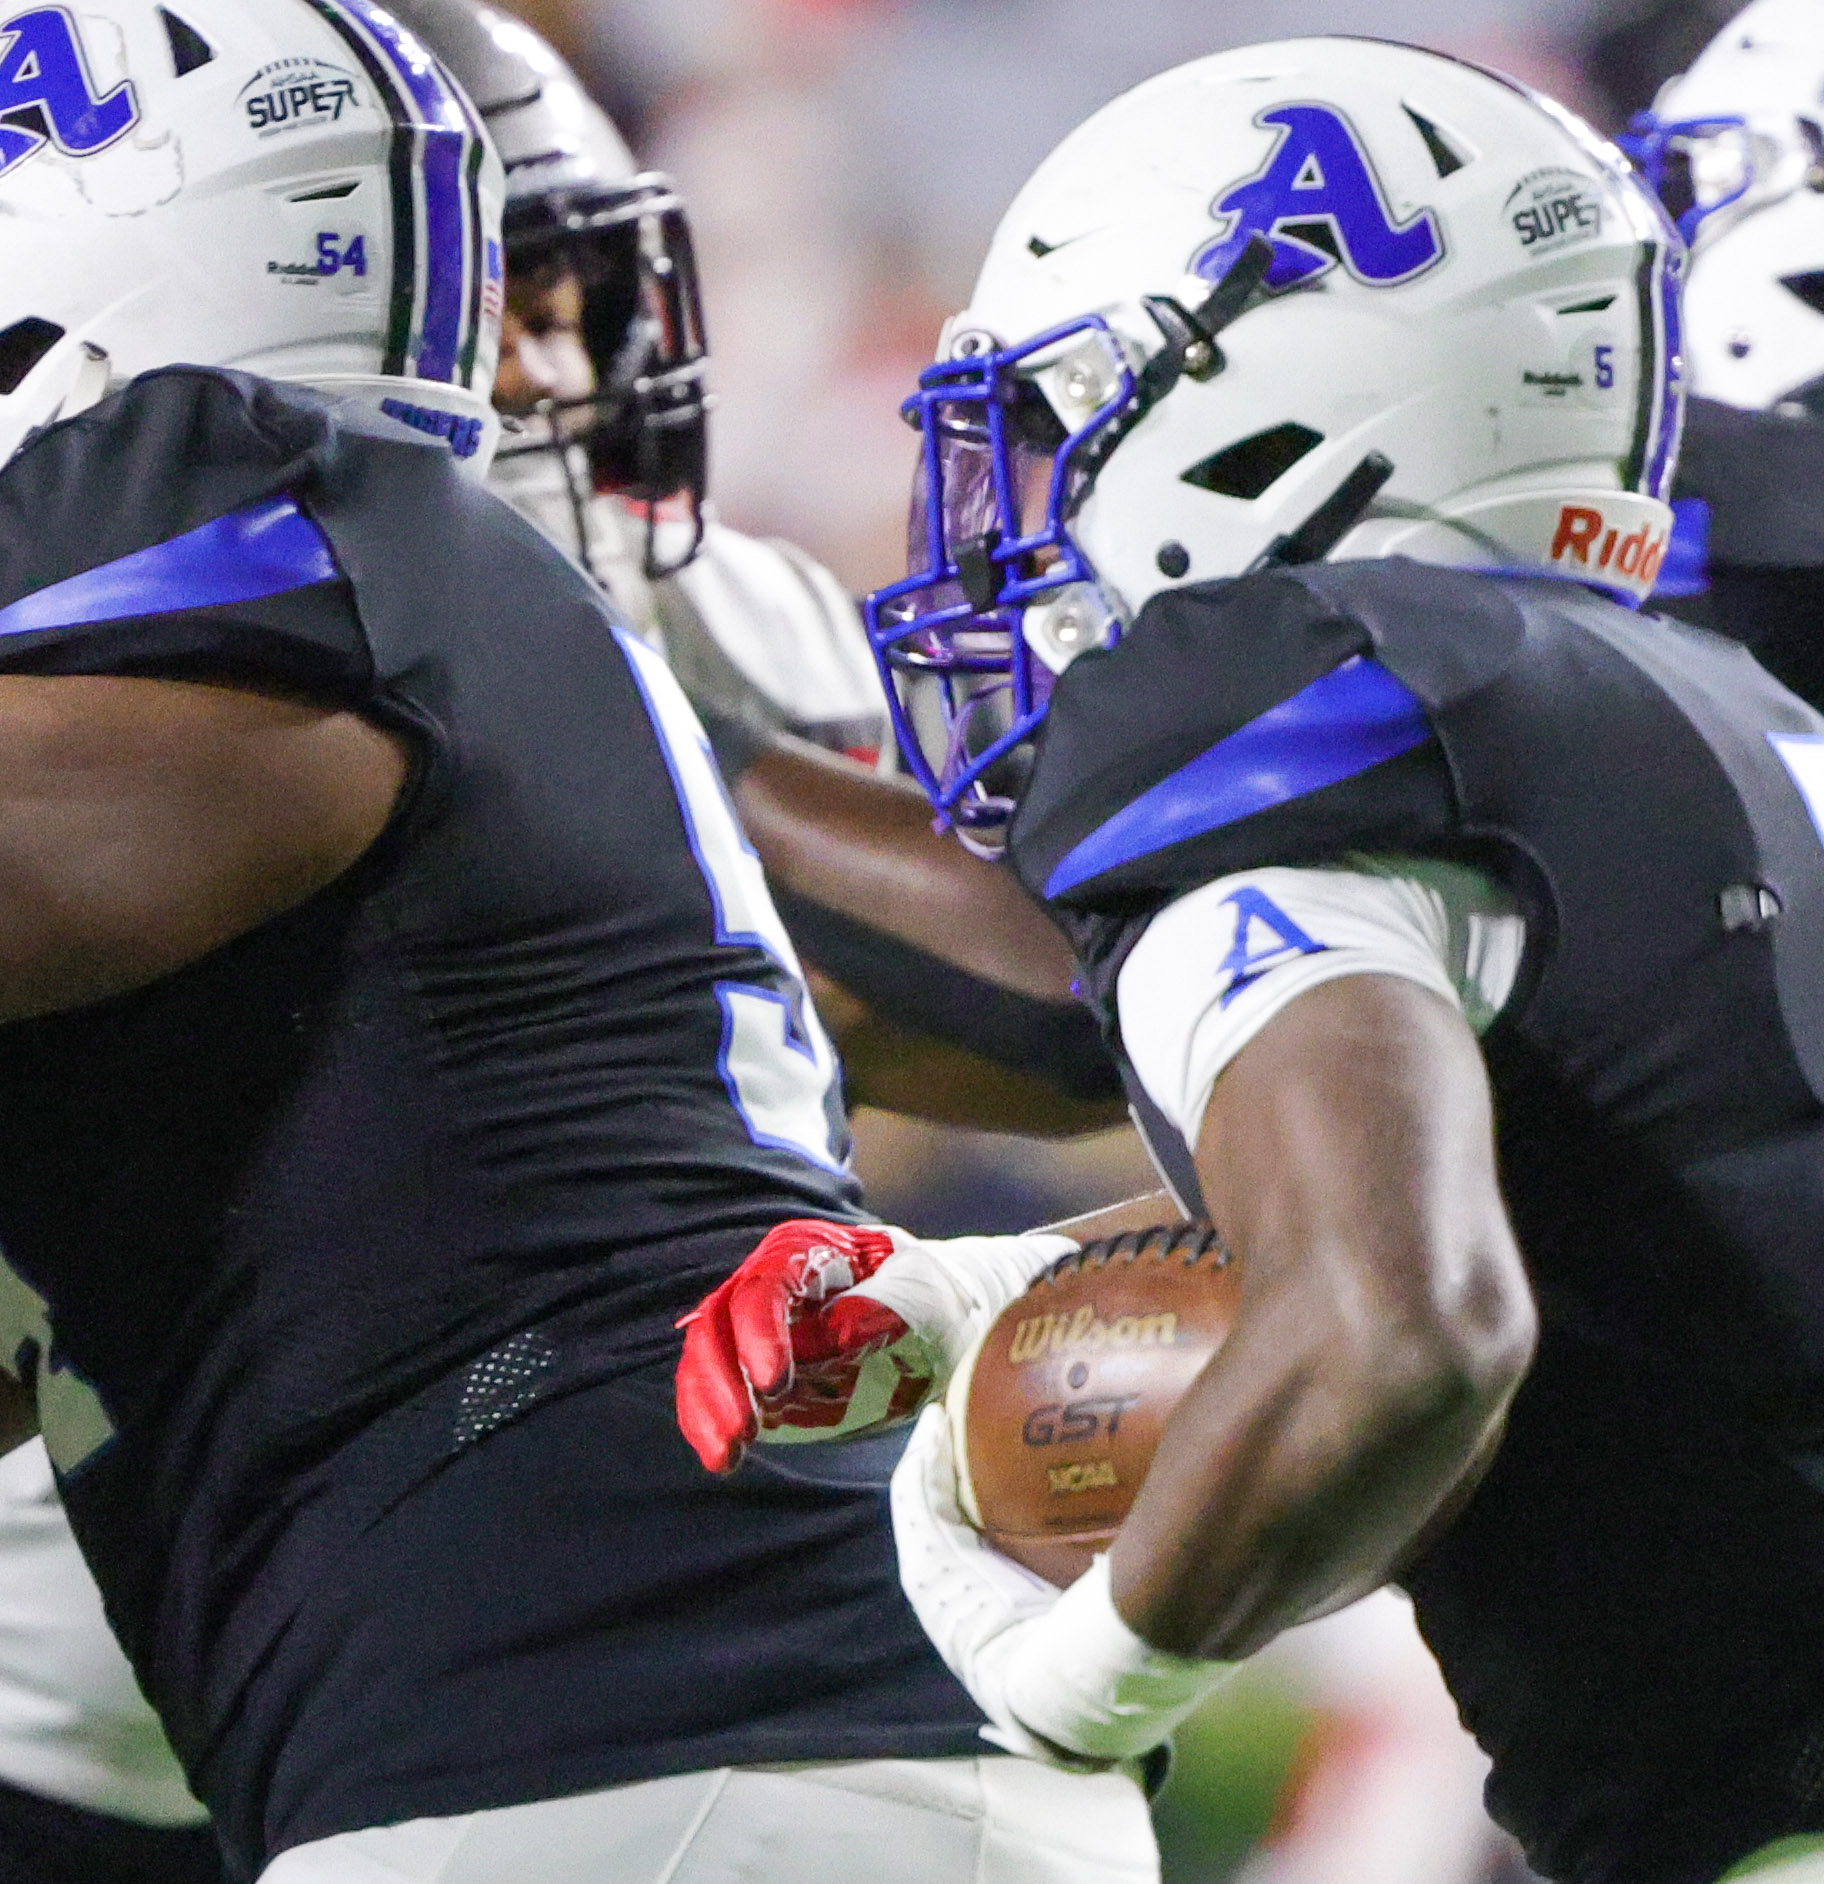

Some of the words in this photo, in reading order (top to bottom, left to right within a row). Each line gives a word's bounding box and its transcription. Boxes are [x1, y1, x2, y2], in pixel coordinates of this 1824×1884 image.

[0, 5, 141, 178] A
[1185, 100, 1445, 294] A
[316, 232, 367, 277] 54
[1594, 345, 1614, 389] 5
[1216, 885, 1329, 1012] A
[1008, 1302, 1178, 1363] Wilson
[1022, 1391, 1142, 1447] GST
